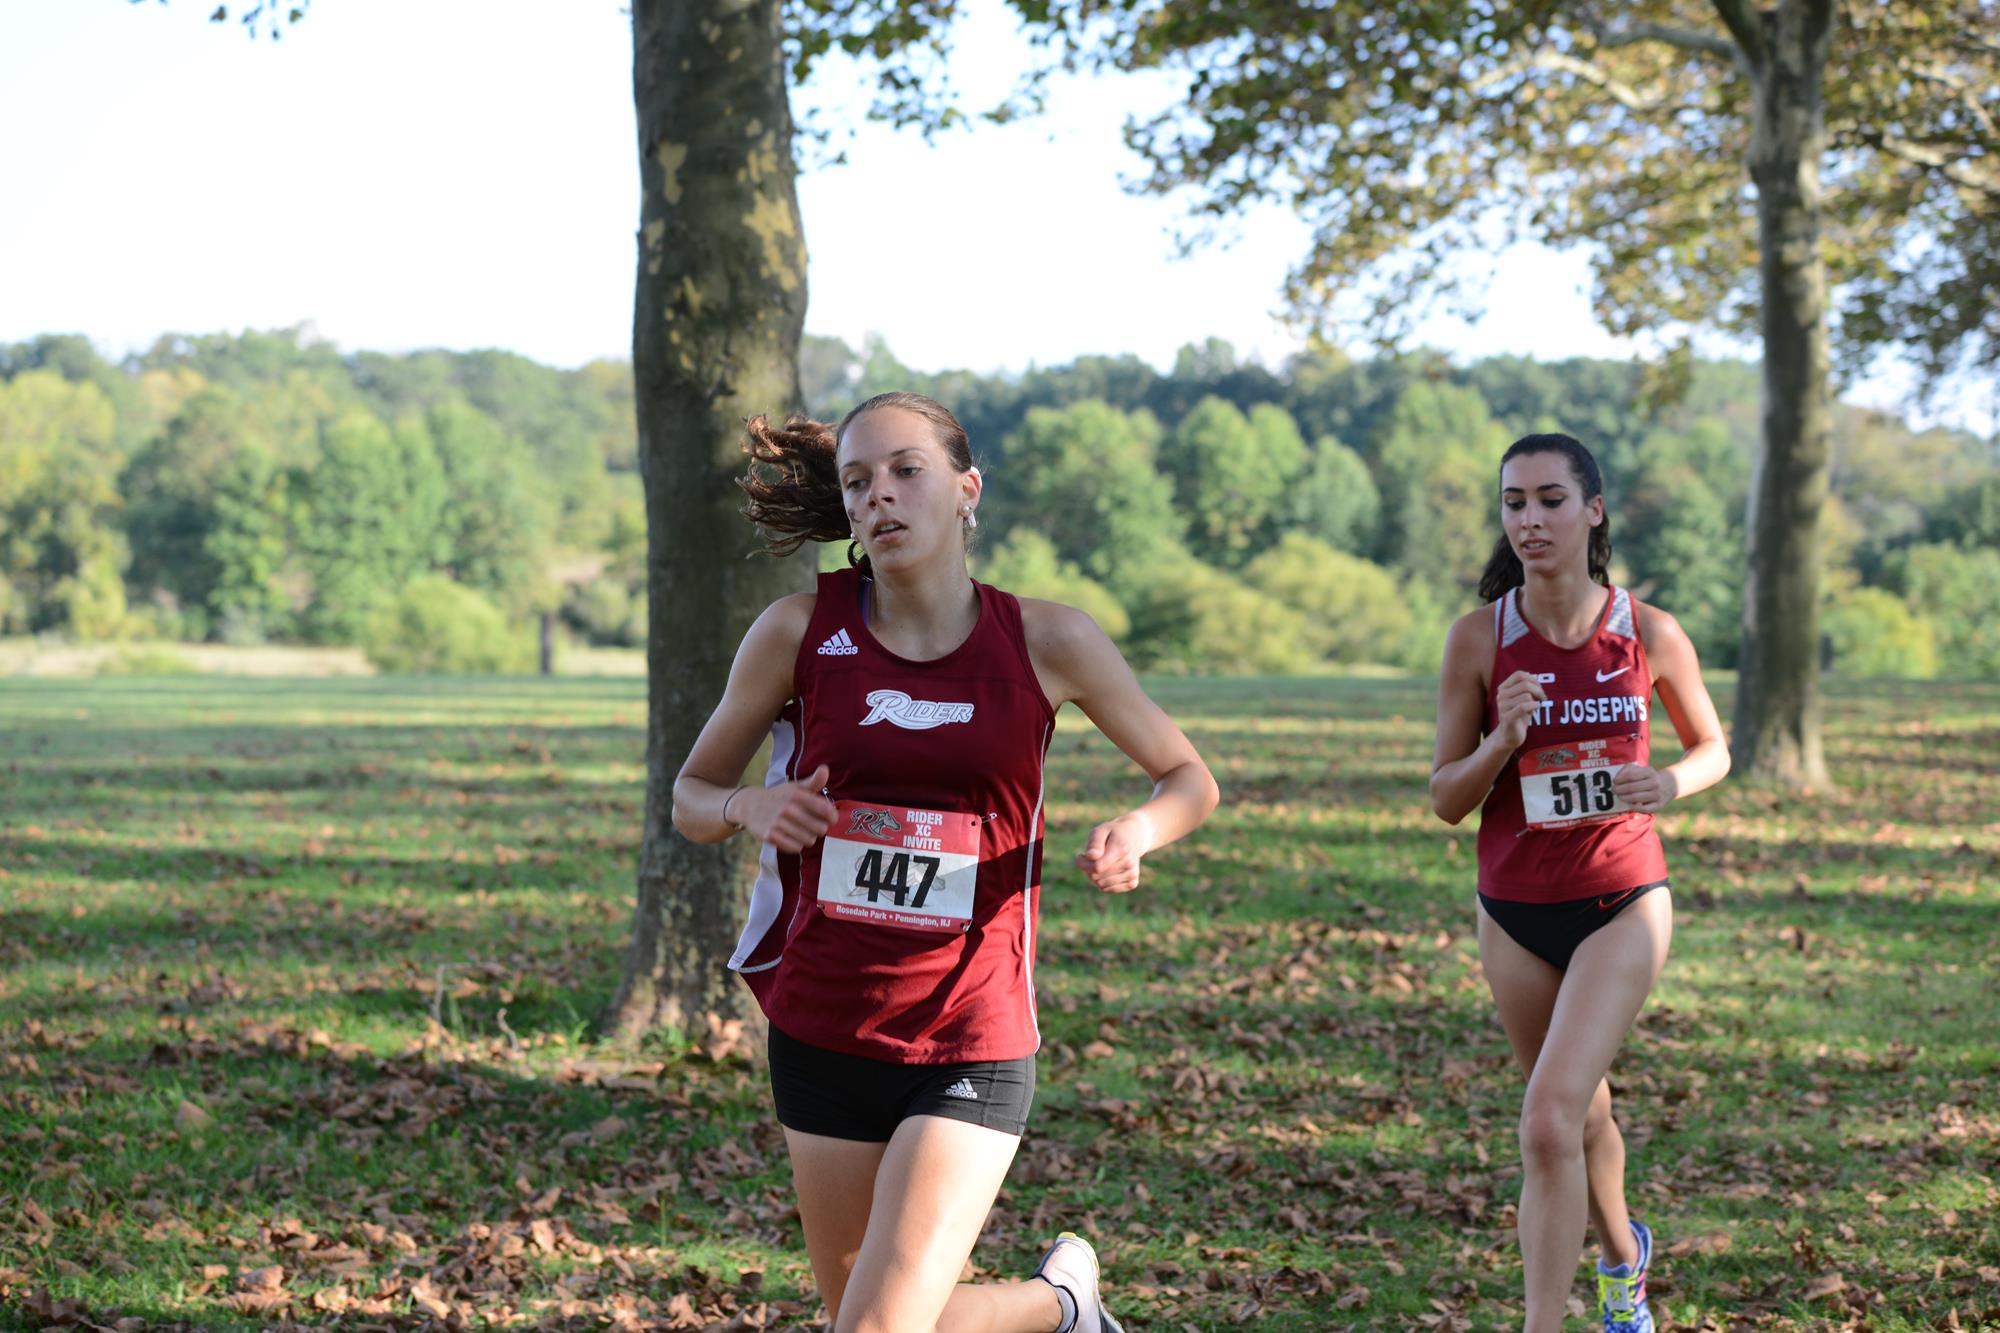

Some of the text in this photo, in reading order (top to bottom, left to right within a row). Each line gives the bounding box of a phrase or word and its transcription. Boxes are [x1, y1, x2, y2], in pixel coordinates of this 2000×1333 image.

[817, 645, 858, 656] adidas
[1560, 696, 1648, 724] JOSEPH'S
[1551, 770, 1615, 816] 513
[906, 810, 943, 826] RIDER
[915, 823, 932, 837] XC
[903, 835, 942, 851] INVITE
[855, 849, 940, 909] 447
[836, 904, 951, 928] Rosedale Park Pennington, NJ
[945, 1088, 978, 1099] adidas
